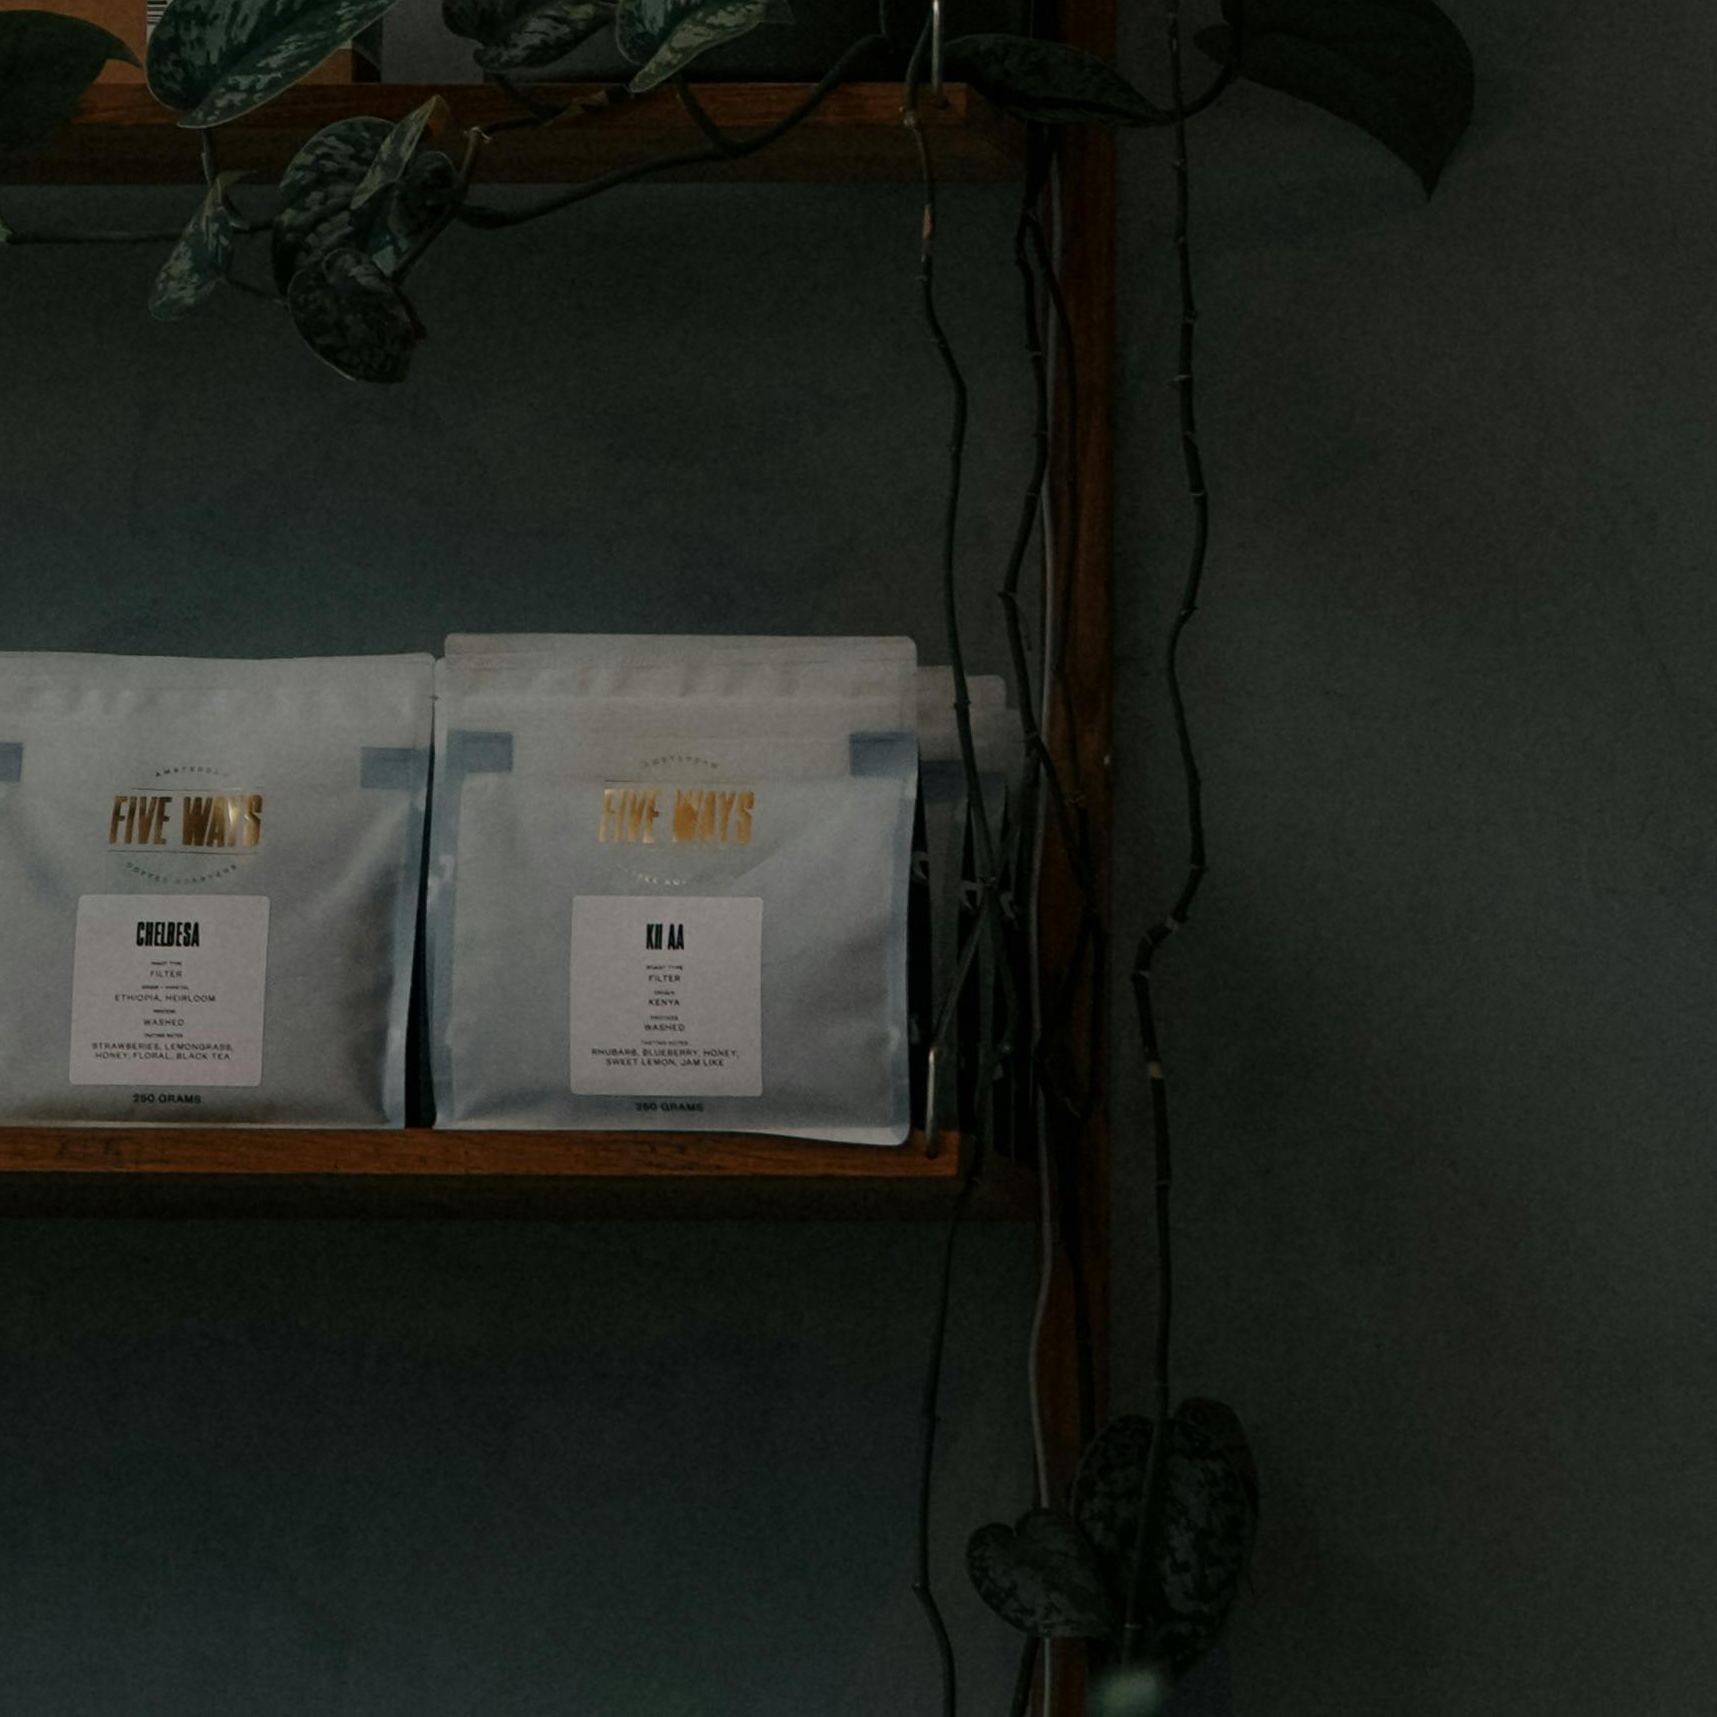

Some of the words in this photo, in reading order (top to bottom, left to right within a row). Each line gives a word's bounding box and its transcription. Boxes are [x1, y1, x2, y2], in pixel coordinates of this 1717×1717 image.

[109, 795, 172, 845] FIVE
[182, 795, 263, 847] WAYS
[599, 788, 661, 843] FIVE
[672, 789, 755, 845] WAYS
[137, 922, 200, 947] CHELBESA
[667, 924, 684, 950] AA
[115, 994, 163, 1003] ETHIOPIA,
[133, 1052, 173, 1060] FLORAL,
[592, 1048, 640, 1056] RHUBARB,
[642, 1048, 699, 1057] BLUEBERRY,
[703, 1049, 739, 1058] HONEY,
[606, 1058, 638, 1066] SWEET
[641, 1058, 679, 1067] LEMON,
[133, 1093, 154, 1103] 250
[158, 1094, 202, 1104] GRAMS
